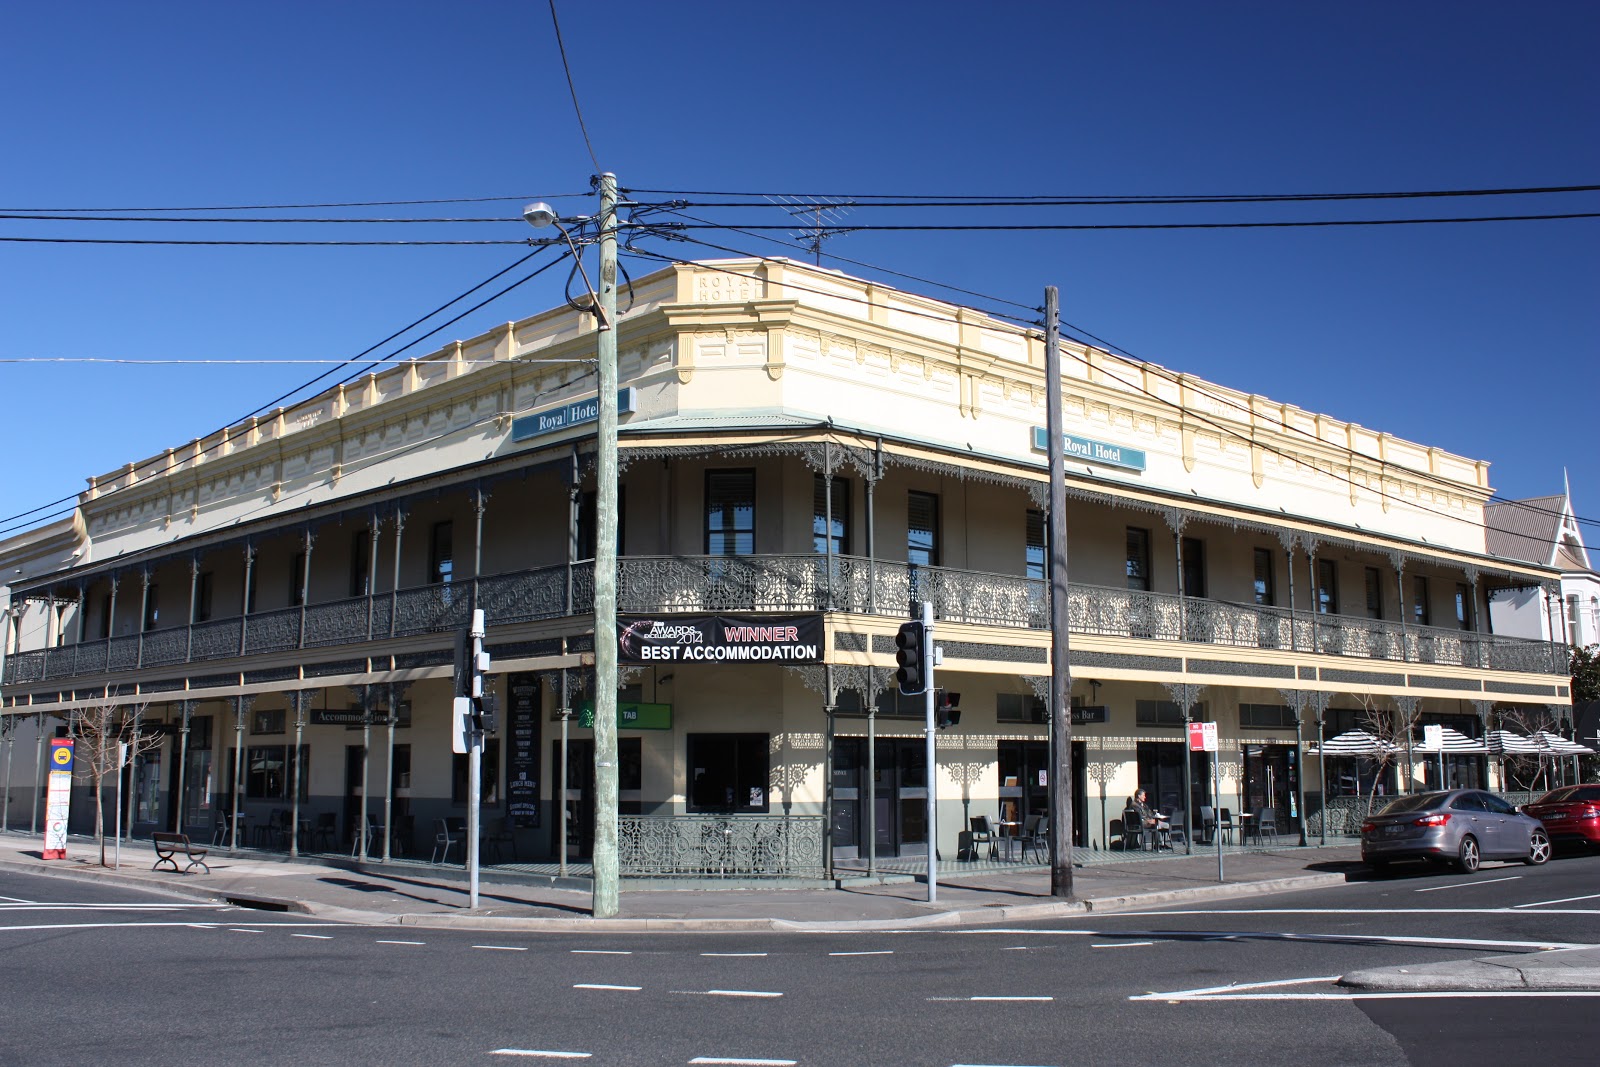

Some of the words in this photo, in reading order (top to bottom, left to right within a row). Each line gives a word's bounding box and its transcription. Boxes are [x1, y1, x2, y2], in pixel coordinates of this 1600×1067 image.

[699, 276, 764, 288] ROYAL
[699, 289, 764, 301] HOTEL
[539, 410, 566, 430] Royal
[571, 401, 599, 422] Hotel
[1063, 437, 1091, 456] Royal
[1095, 443, 1120, 461] Hotel
[649, 626, 696, 636] AWARDS
[724, 626, 799, 642] WINNER
[676, 633, 703, 645] 2014
[641, 646, 680, 660] BEST
[683, 645, 817, 660] ACCOMMODATION
[319, 711, 388, 722] Accommodtion
[622, 711, 637, 720] TAB
[1081, 711, 1095, 720] Bar
